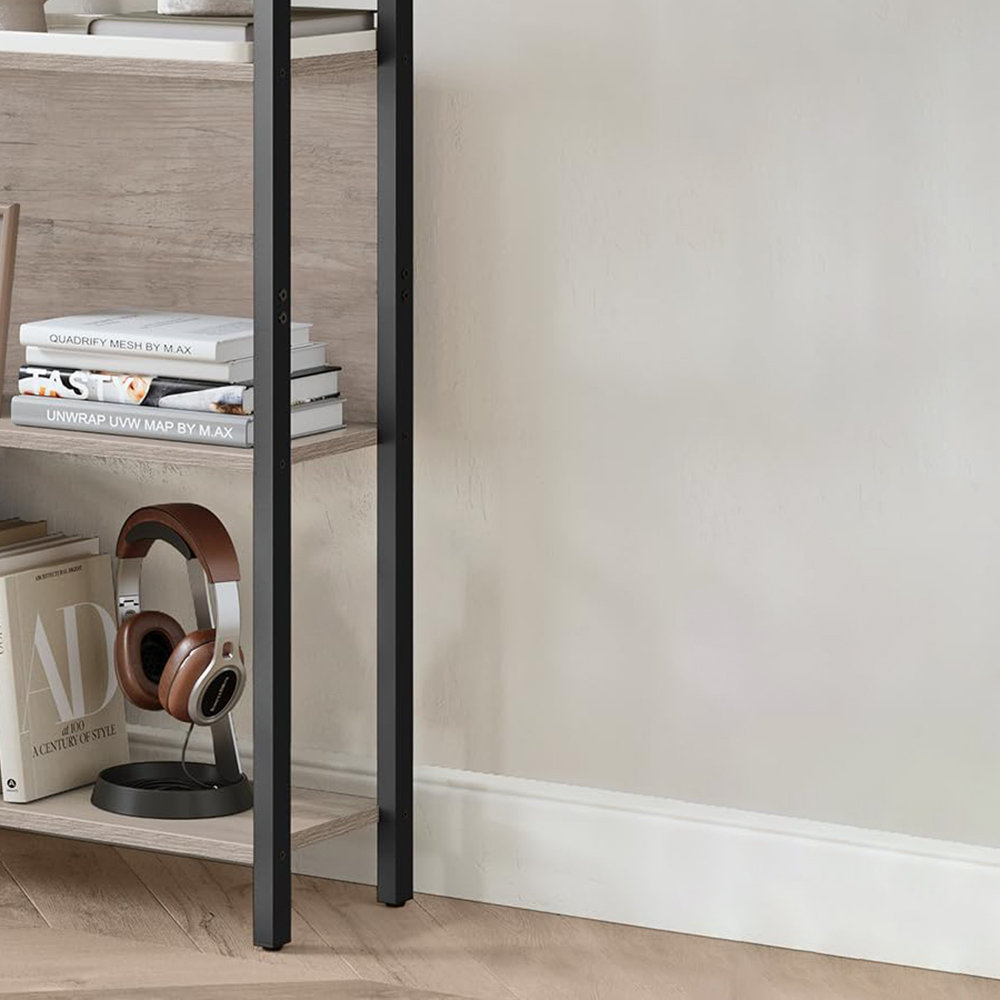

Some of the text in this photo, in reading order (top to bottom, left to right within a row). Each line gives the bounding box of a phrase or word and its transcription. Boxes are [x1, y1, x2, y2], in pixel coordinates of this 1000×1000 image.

[50, 334, 192, 355] QUADRIFY MESH BY M.AX
[46, 409, 233, 439] UNWRAP UVW MAP BY M.AX
[19, 602, 117, 735] AD
[32, 723, 117, 758] A CENTURY OF STYLE
[70, 719, 85, 735] 100
